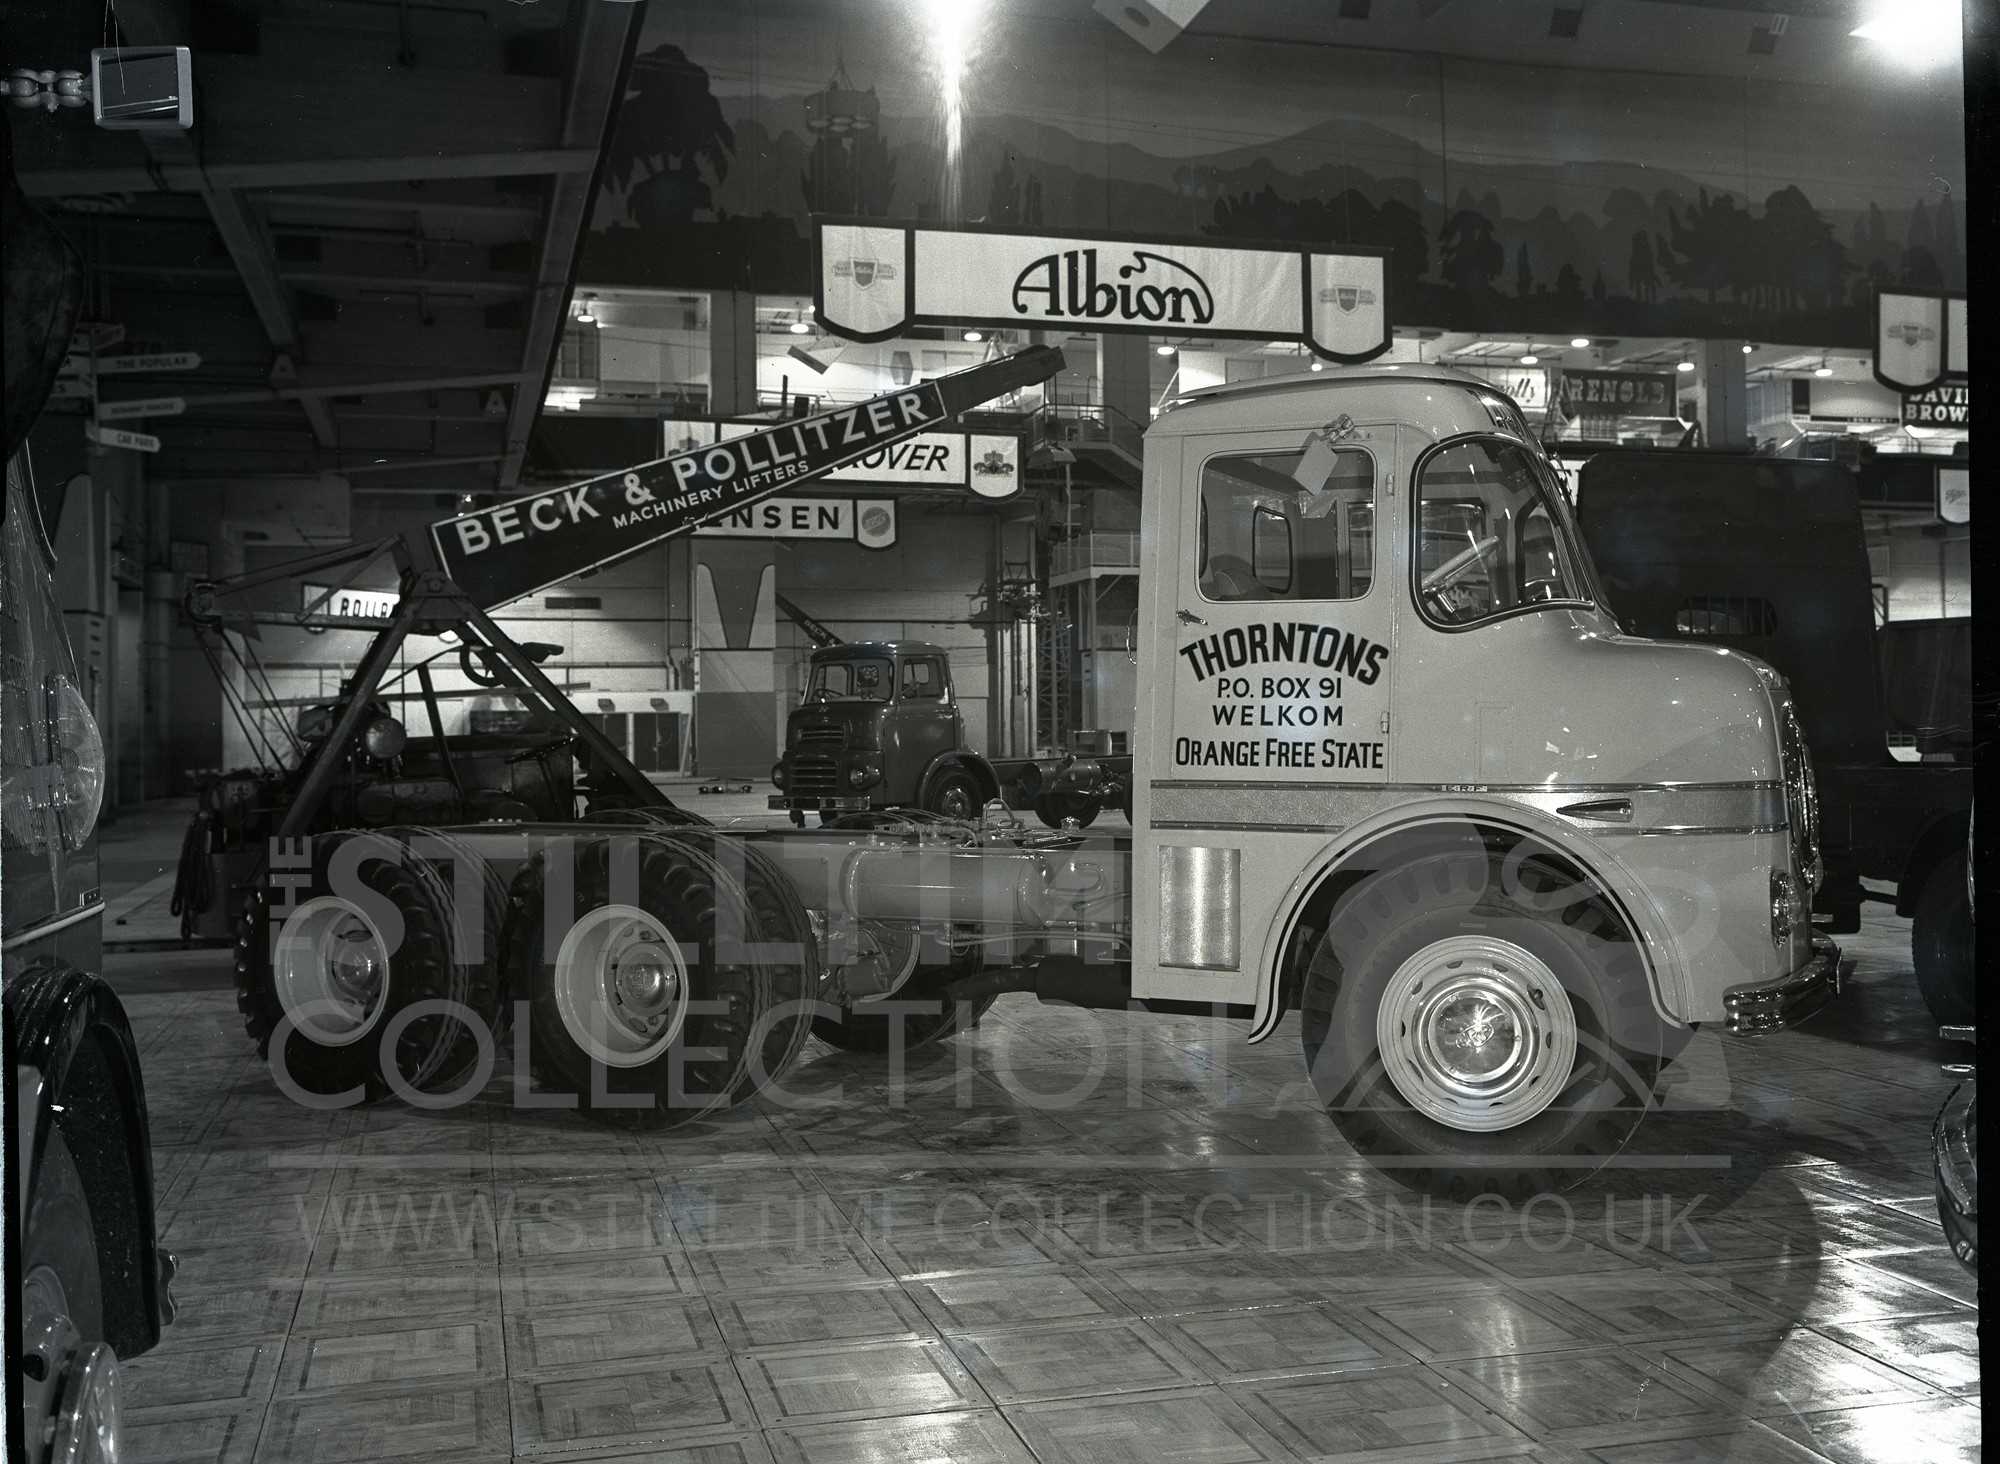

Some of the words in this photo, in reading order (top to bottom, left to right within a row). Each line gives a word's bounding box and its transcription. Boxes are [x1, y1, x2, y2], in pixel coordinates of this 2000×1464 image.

[1012, 248, 1215, 324] Albion
[116, 359, 135, 369] THE
[140, 356, 187, 368] POPULAR
[1905, 404, 1968, 422] BROW
[118, 432, 132, 445] CAR
[135, 435, 155, 449] PARK
[851, 443, 950, 471] OVER
[455, 486, 600, 556] BECK
[624, 473, 657, 506] &
[671, 393, 928, 492] POLLITZER
[612, 486, 724, 529] MACHINERY
[733, 460, 809, 494] LIFTERS
[703, 505, 840, 530] NSEN
[1179, 622, 1389, 686] THORNTONS
[1217, 677, 1254, 699] P.O.
[1261, 677, 1311, 699] BOX
[1319, 677, 1342, 699] 91
[1212, 704, 1343, 727] WELKOM
[1176, 736, 1260, 767] ORANGE
[1265, 737, 1316, 768] FREE
[1321, 738, 1384, 769] STATE
